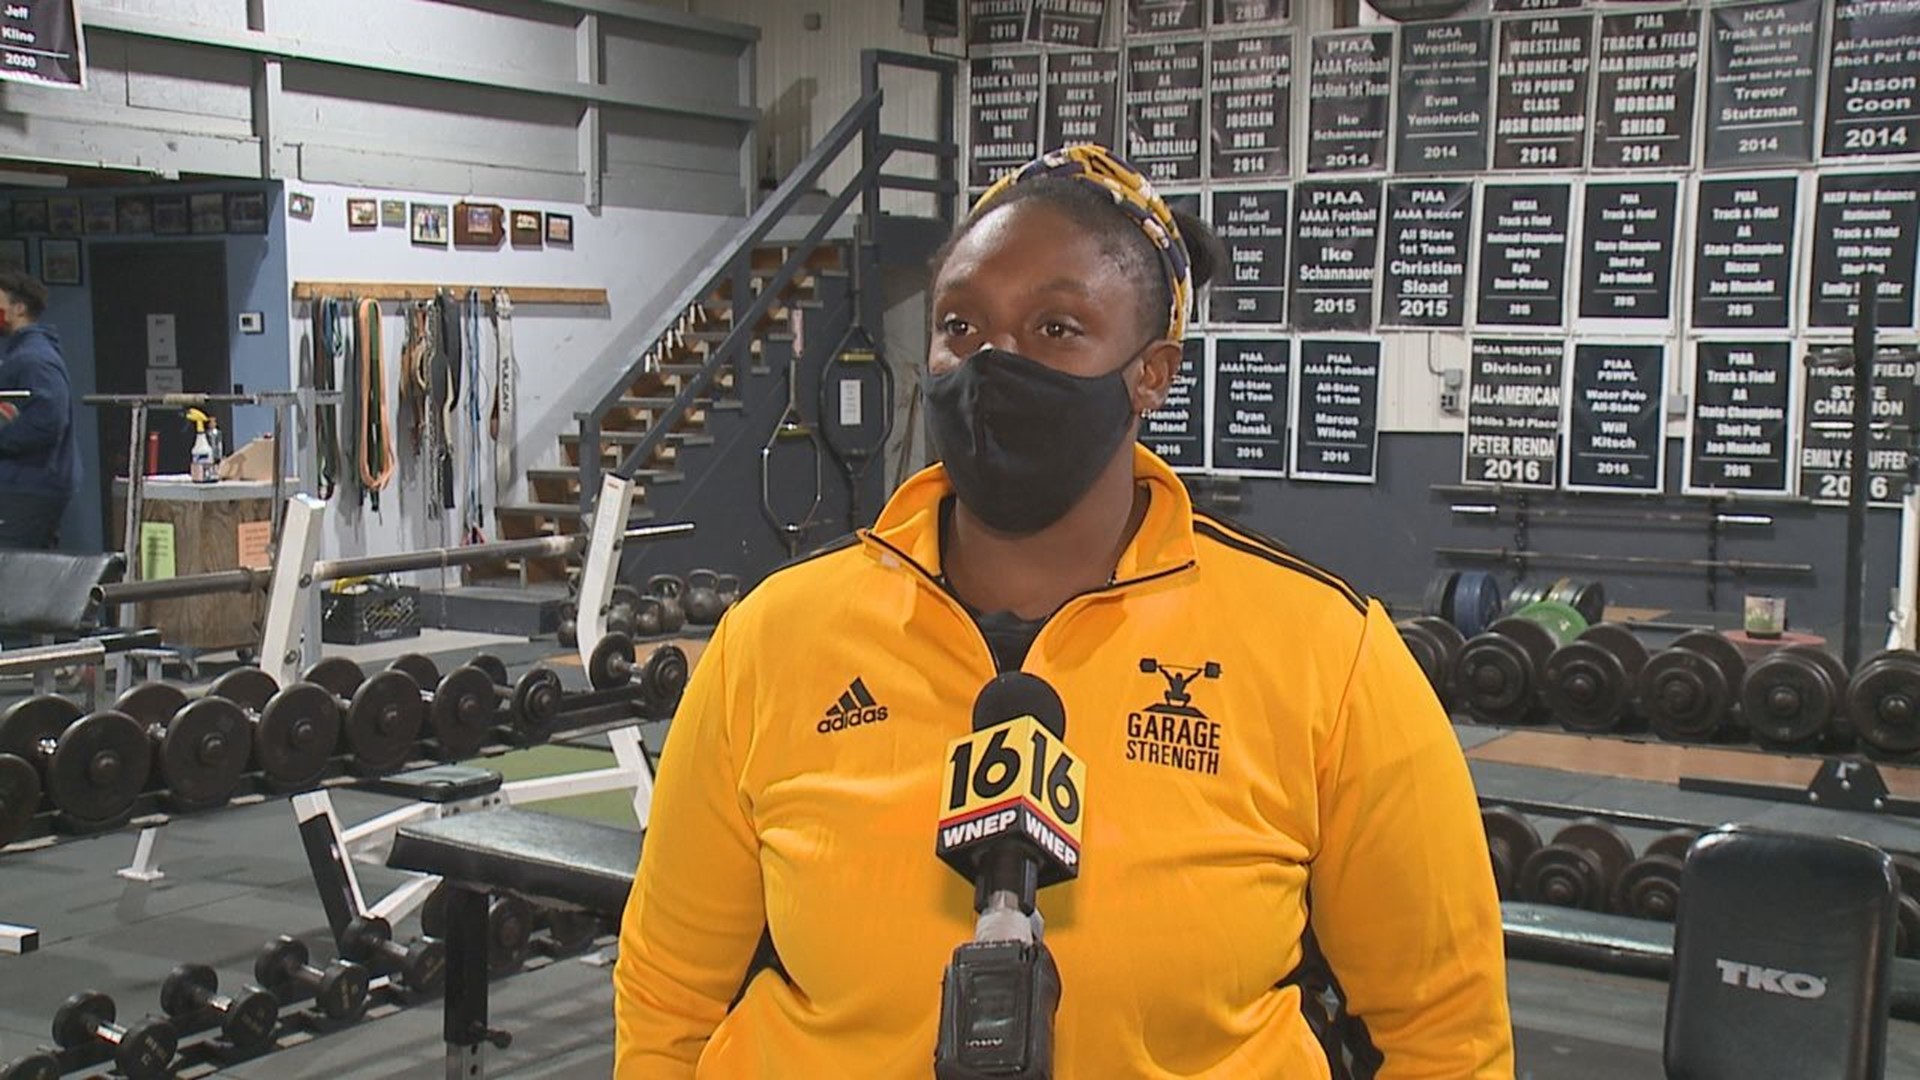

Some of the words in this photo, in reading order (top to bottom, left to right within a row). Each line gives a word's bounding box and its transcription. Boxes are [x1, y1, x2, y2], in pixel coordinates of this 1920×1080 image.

[1635, 14, 1665, 29] PIAA
[1743, 8, 1786, 22] NCAA
[1426, 27, 1462, 39] NCAA
[1531, 20, 1560, 34] PIAA
[1718, 28, 1757, 41] Track
[1762, 26, 1773, 36] &
[1778, 22, 1814, 34] Field
[2, 26, 36, 43] Kline
[1327, 40, 1376, 54] PIAA
[1412, 42, 1477, 56] Wrestling
[1510, 37, 1582, 55] WRESTLING
[1603, 36, 1645, 52] TRACK
[1648, 37, 1658, 49] &
[1661, 32, 1698, 48] FIELD
[5, 53, 37, 69] 2020
[1133, 60, 1163, 72] TRACK
[1173, 58, 1198, 69] FIELD
[1213, 59, 1247, 74] TRACK
[1260, 56, 1290, 69] FIELD
[1345, 57, 1391, 72] Football
[1499, 62, 1515, 75] AA
[1517, 58, 1590, 75] RUNNER-UP
[1600, 57, 1625, 72] AAA
[1626, 53, 1698, 70] RUNNER-UP
[1833, 54, 1868, 67] Shot
[1874, 52, 1901, 65] Put
[1364, 81, 1391, 95] Team
[1534, 79, 1576, 93] POUND
[1617, 77, 1649, 91] SHOT
[1650, 75, 1676, 90] PUT
[1844, 76, 1917, 93] Jason
[1226, 95, 1252, 108] SHOT
[1254, 93, 1275, 106] PUT
[1734, 86, 1788, 101] Trevor
[1425, 95, 1459, 107] Evan
[1523, 98, 1560, 112] CLASS
[1614, 95, 1676, 112] MORGAN
[1846, 97, 1912, 113] Coon
[1337, 115, 1360, 125] Ike
[1721, 105, 1799, 121] Stutzman
[1062, 121, 1097, 135] JASON
[1498, 119, 1529, 134] JOSH
[1738, 137, 1779, 153] 2014
[1844, 127, 1907, 149] 2014
[1424, 145, 1459, 159] 2014
[1520, 147, 1557, 163] 2014
[1622, 146, 1660, 162] 2014
[1233, 157, 1266, 172] 2014
[1325, 153, 1370, 167] 2014
[1151, 163, 1178, 177] 2014
[1313, 191, 1365, 205] PIAA
[1411, 190, 1445, 203] PIAA
[1300, 209, 1330, 222] AAAA
[1332, 208, 1377, 222] Football
[1393, 210, 1422, 220] AAAA
[1425, 209, 1463, 220] Soccer
[1351, 227, 1375, 237] Team
[1400, 229, 1417, 241] All
[1419, 229, 1454, 241] State
[1232, 246, 1263, 262] Isaac
[1321, 247, 1354, 261] Ike
[1399, 243, 1418, 256] 1st
[1420, 244, 1456, 256] Team
[1235, 264, 1260, 281] Lutz
[1390, 261, 1464, 276] Christian
[1402, 279, 1449, 294] Sload
[1313, 298, 1356, 313] 2015
[1400, 299, 1448, 317] 2015
[1727, 304, 1754, 317] 2015
[1502, 346, 1563, 356] WRESTLING
[1327, 354, 1352, 364] PIAA
[1604, 359, 1633, 370] PIAA
[1246, 363, 1287, 374] Football
[1304, 364, 1332, 375] AAAA
[1334, 365, 1376, 376] Football
[1482, 362, 1542, 375] Division
[1545, 364, 1553, 375] I
[1874, 363, 1915, 378] FIELD
[1707, 370, 1737, 384] Track
[1748, 371, 1776, 384] Field
[1231, 380, 1272, 391] All-State
[1316, 382, 1360, 394] All-State
[1230, 392, 1245, 402] 1st
[1247, 393, 1273, 403] Team
[1316, 395, 1331, 405] 1st
[1333, 395, 1361, 406] Team
[1472, 384, 1561, 406] ALL-AMERICAN
[1586, 389, 1620, 402] Water
[1622, 390, 1647, 402] Polo
[1592, 402, 1641, 414] All-State
[1698, 405, 1726, 419] State
[1727, 406, 1783, 420] Champion
[1236, 410, 1265, 424] Ryan
[1315, 413, 1359, 427] Marcus
[1507, 417, 1526, 428] 3rd
[1527, 419, 1558, 430] Place
[1150, 421, 1187, 433] Roland
[1316, 427, 1357, 440] Wilson
[1601, 421, 1628, 434] Will
[1155, 444, 1181, 455] 2016
[1470, 434, 1511, 456] PETER
[1512, 436, 1557, 458] RENDA
[1592, 436, 1637, 450] Kitsch
[1236, 447, 1264, 459] 2016
[1322, 451, 1350, 463] 2016
[1803, 448, 1844, 469] EMILY
[1484, 458, 1541, 482] 2016
[1597, 462, 1631, 475] 2016
[1724, 464, 1752, 478] 2016
[817, 704, 889, 733] adidas
[1127, 713, 1221, 751] GARAGE
[1125, 740, 1220, 776] STRENGTH
[949, 728, 1021, 810] 16
[1030, 732, 1080, 825] 16
[943, 809, 1018, 848] WNEP
[1024, 815, 1079, 868] WNEP
[1716, 958, 1826, 999] TKO
